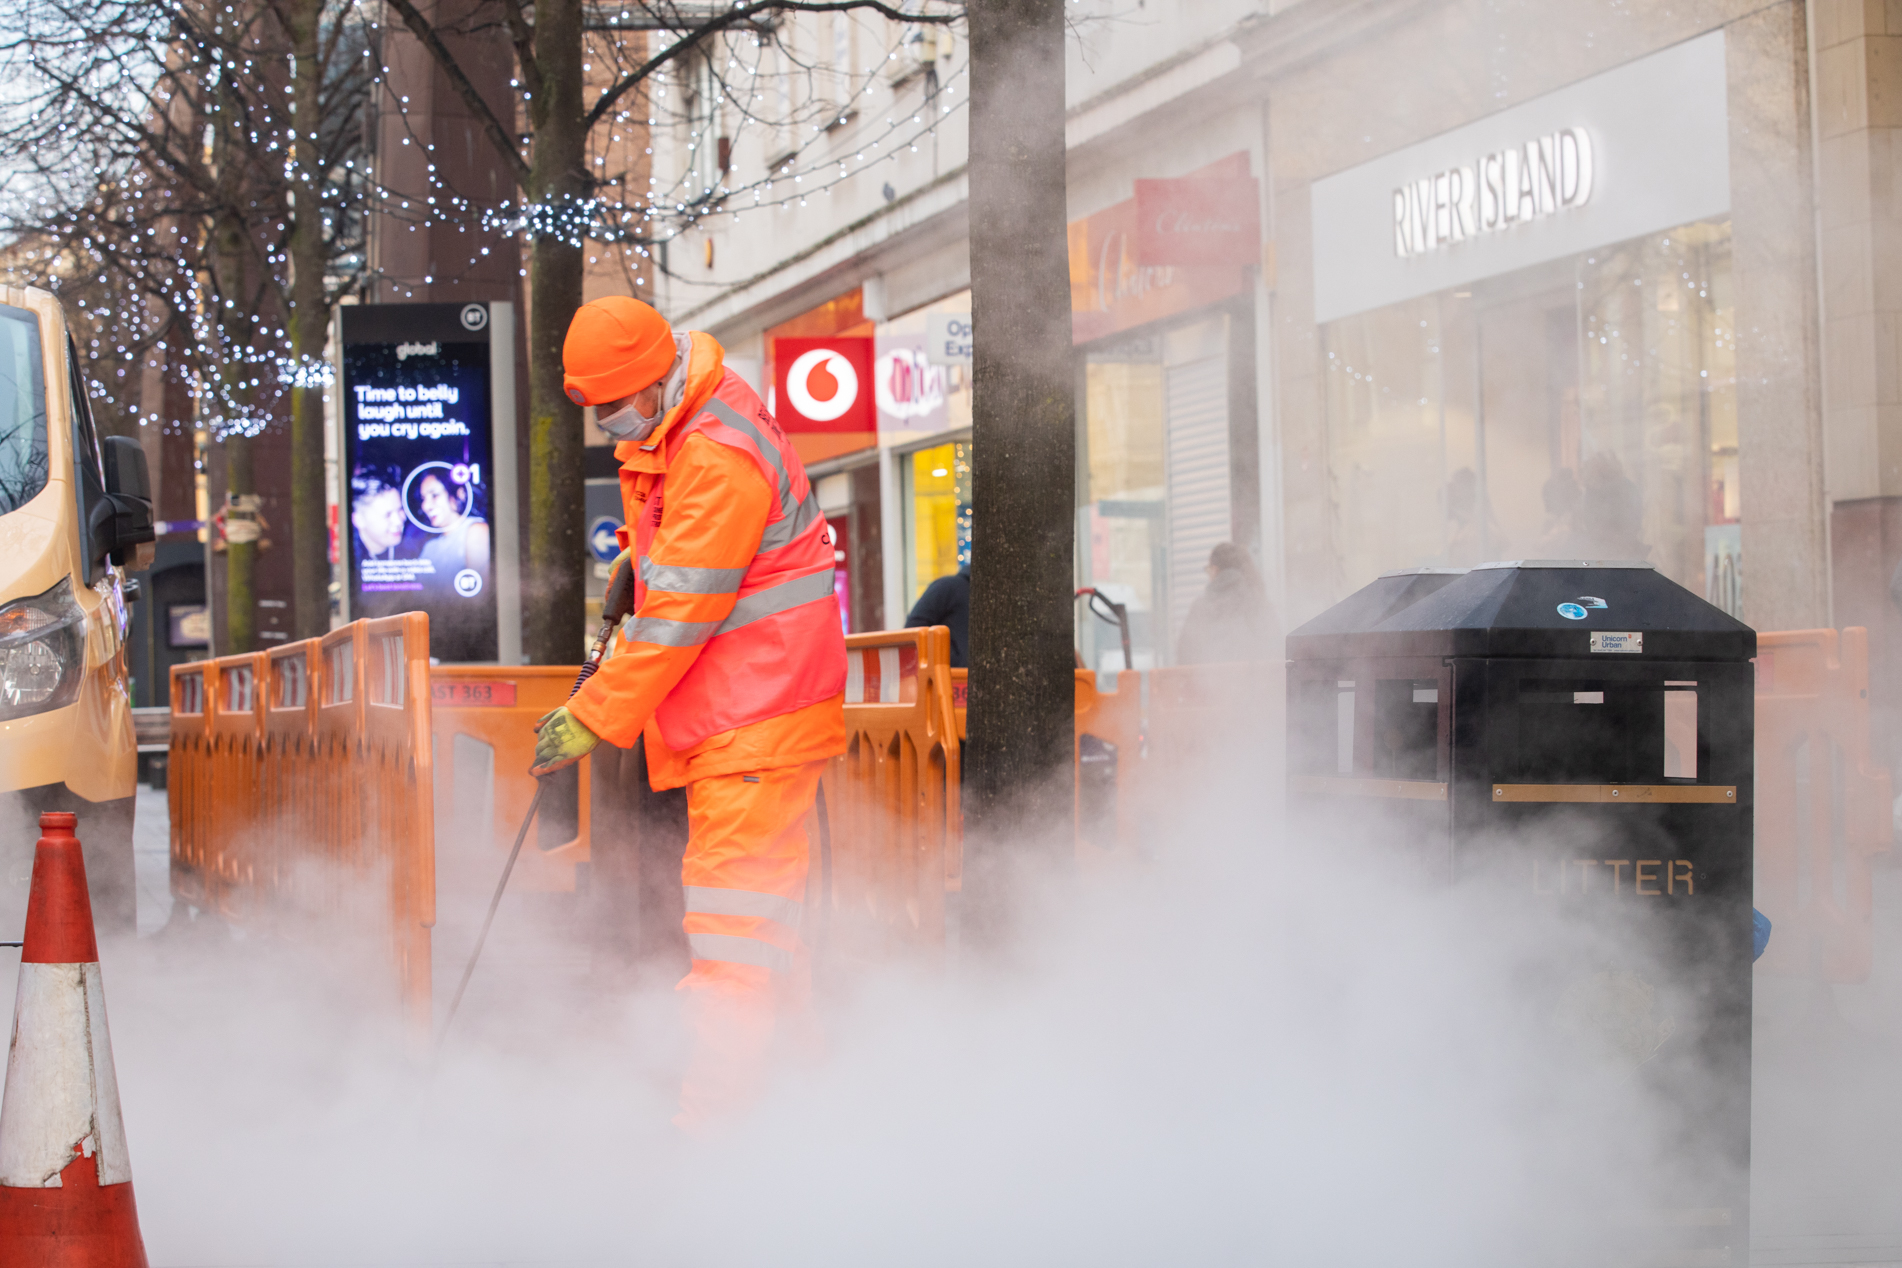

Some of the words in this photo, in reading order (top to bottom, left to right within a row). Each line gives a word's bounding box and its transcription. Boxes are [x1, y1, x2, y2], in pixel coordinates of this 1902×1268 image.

[1393, 166, 1476, 258] RIVER
[1477, 127, 1592, 232] ISLAND
[353, 384, 397, 402] Time
[397, 385, 417, 402] to
[417, 383, 459, 404] belly
[357, 402, 405, 423] laugh
[405, 401, 444, 419] until
[357, 422, 391, 441] you
[391, 422, 419, 440] cry
[419, 418, 471, 440] again.
[462, 685, 492, 700] 363
[1532, 859, 1694, 896] LITTER
